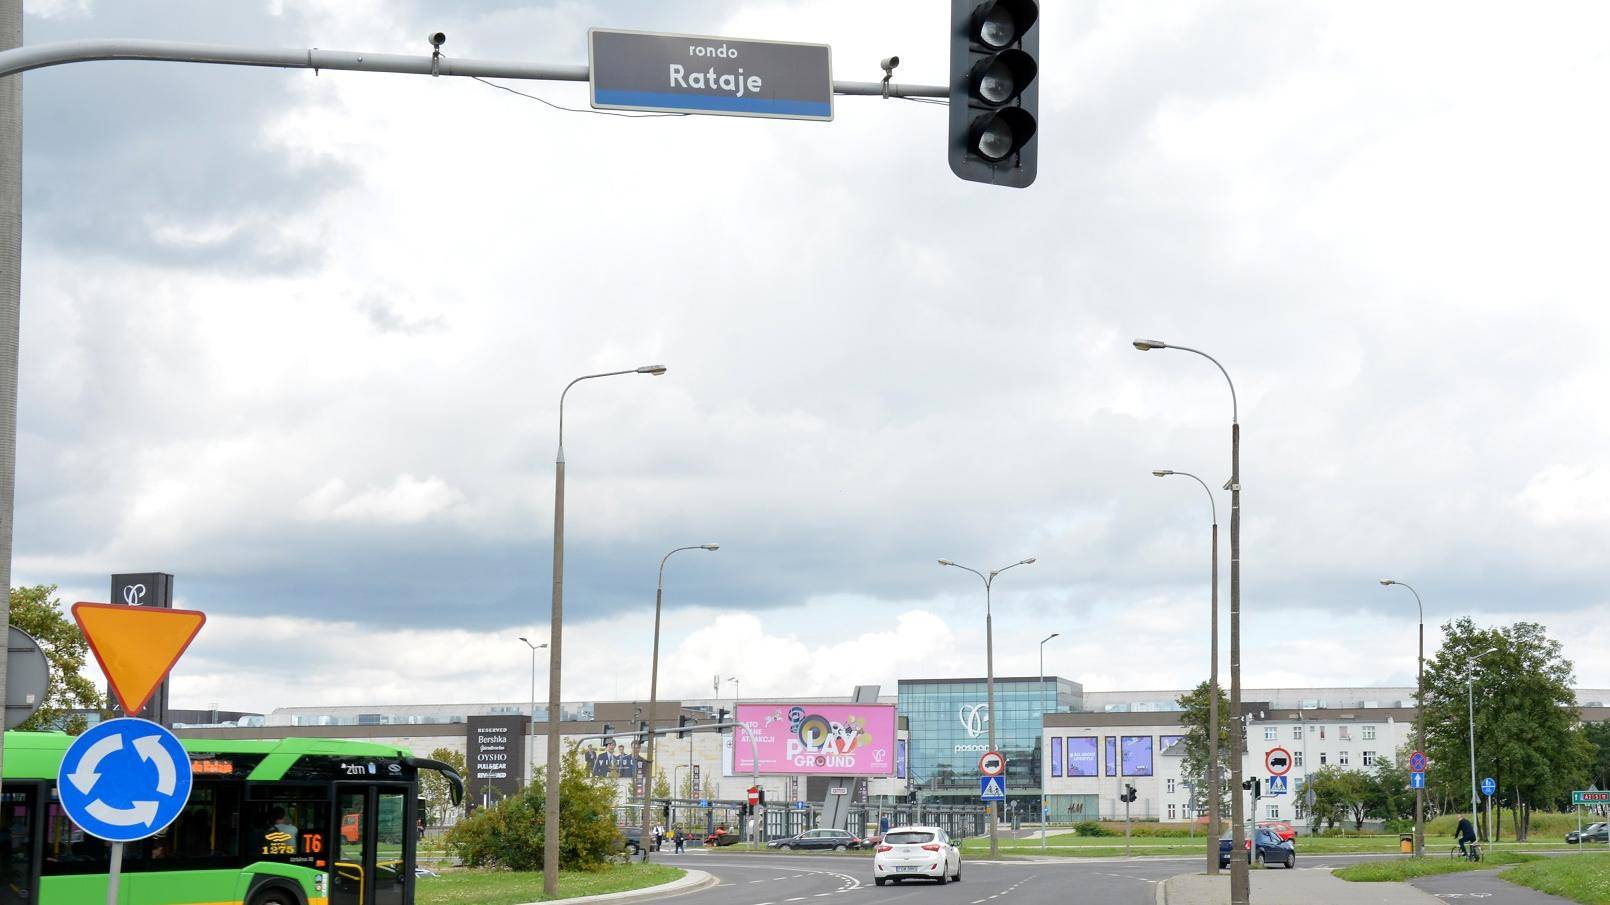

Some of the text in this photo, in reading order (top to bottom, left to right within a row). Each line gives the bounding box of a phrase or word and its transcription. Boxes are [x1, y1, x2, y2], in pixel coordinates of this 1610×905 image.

[689, 44, 738, 58] rondo
[669, 64, 762, 97] Rataje
[478, 735, 507, 743] Bershka
[786, 729, 859, 761] PLAY
[477, 753, 507, 761] OYSHO
[794, 755, 856, 768] GROUND
[303, 834, 322, 853] T6
[261, 846, 295, 855] 1275
